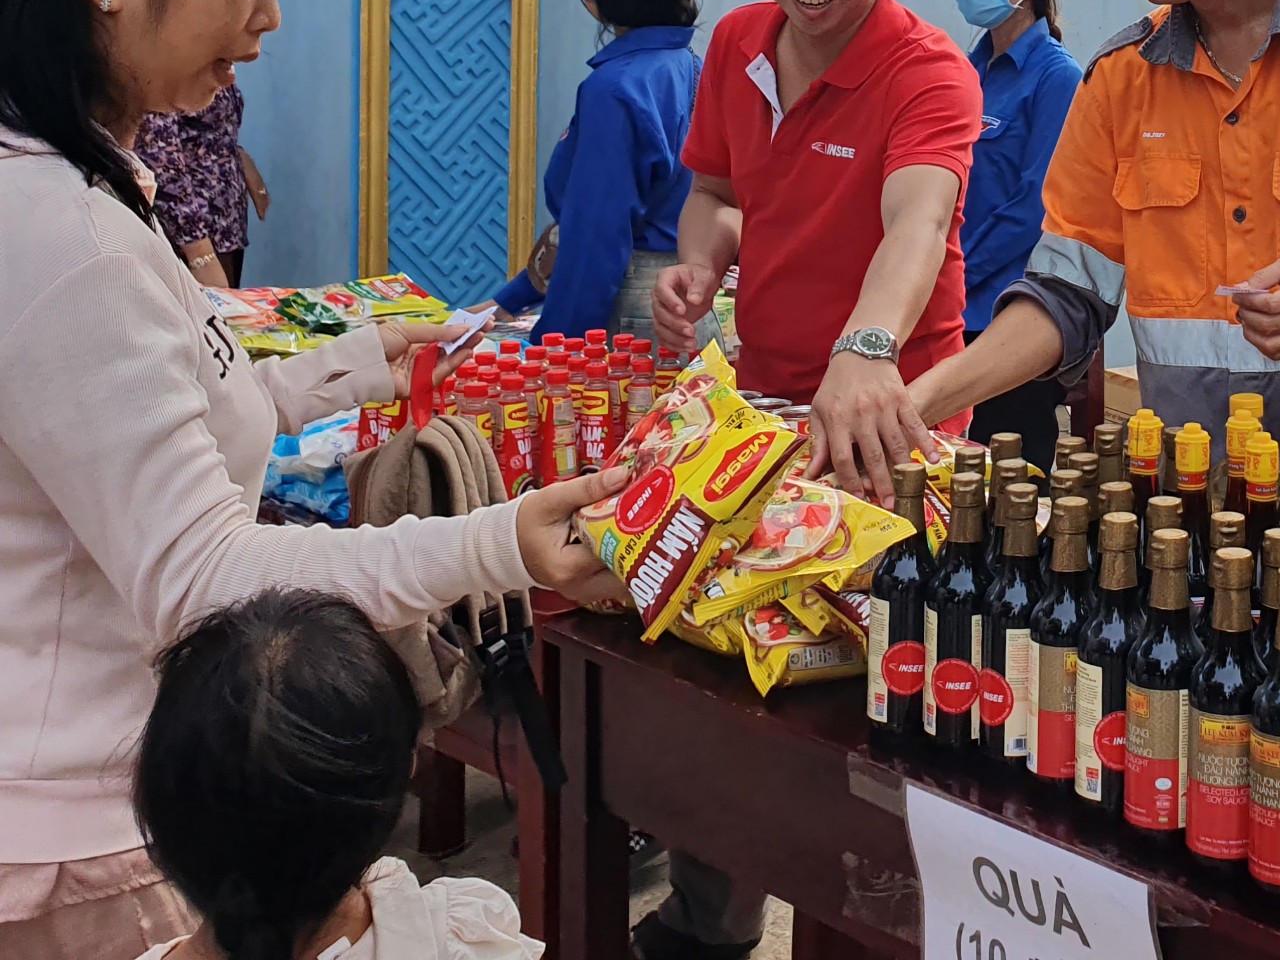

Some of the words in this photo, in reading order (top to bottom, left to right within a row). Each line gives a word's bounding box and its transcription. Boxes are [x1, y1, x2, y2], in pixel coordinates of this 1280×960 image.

[826, 144, 856, 159] INSEE
[711, 433, 769, 495] Maggi
[625, 486, 653, 520] INSEE
[655, 505, 704, 559] NẤM
[628, 550, 673, 614] HƯƠN
[898, 663, 923, 673] INSEE
[945, 681, 972, 690] INSEE
[983, 691, 1004, 703] INSEE
[1207, 795, 1222, 803] SOY
[972, 856, 1091, 949] QUÀ
[956, 922, 1007, 960] (10
